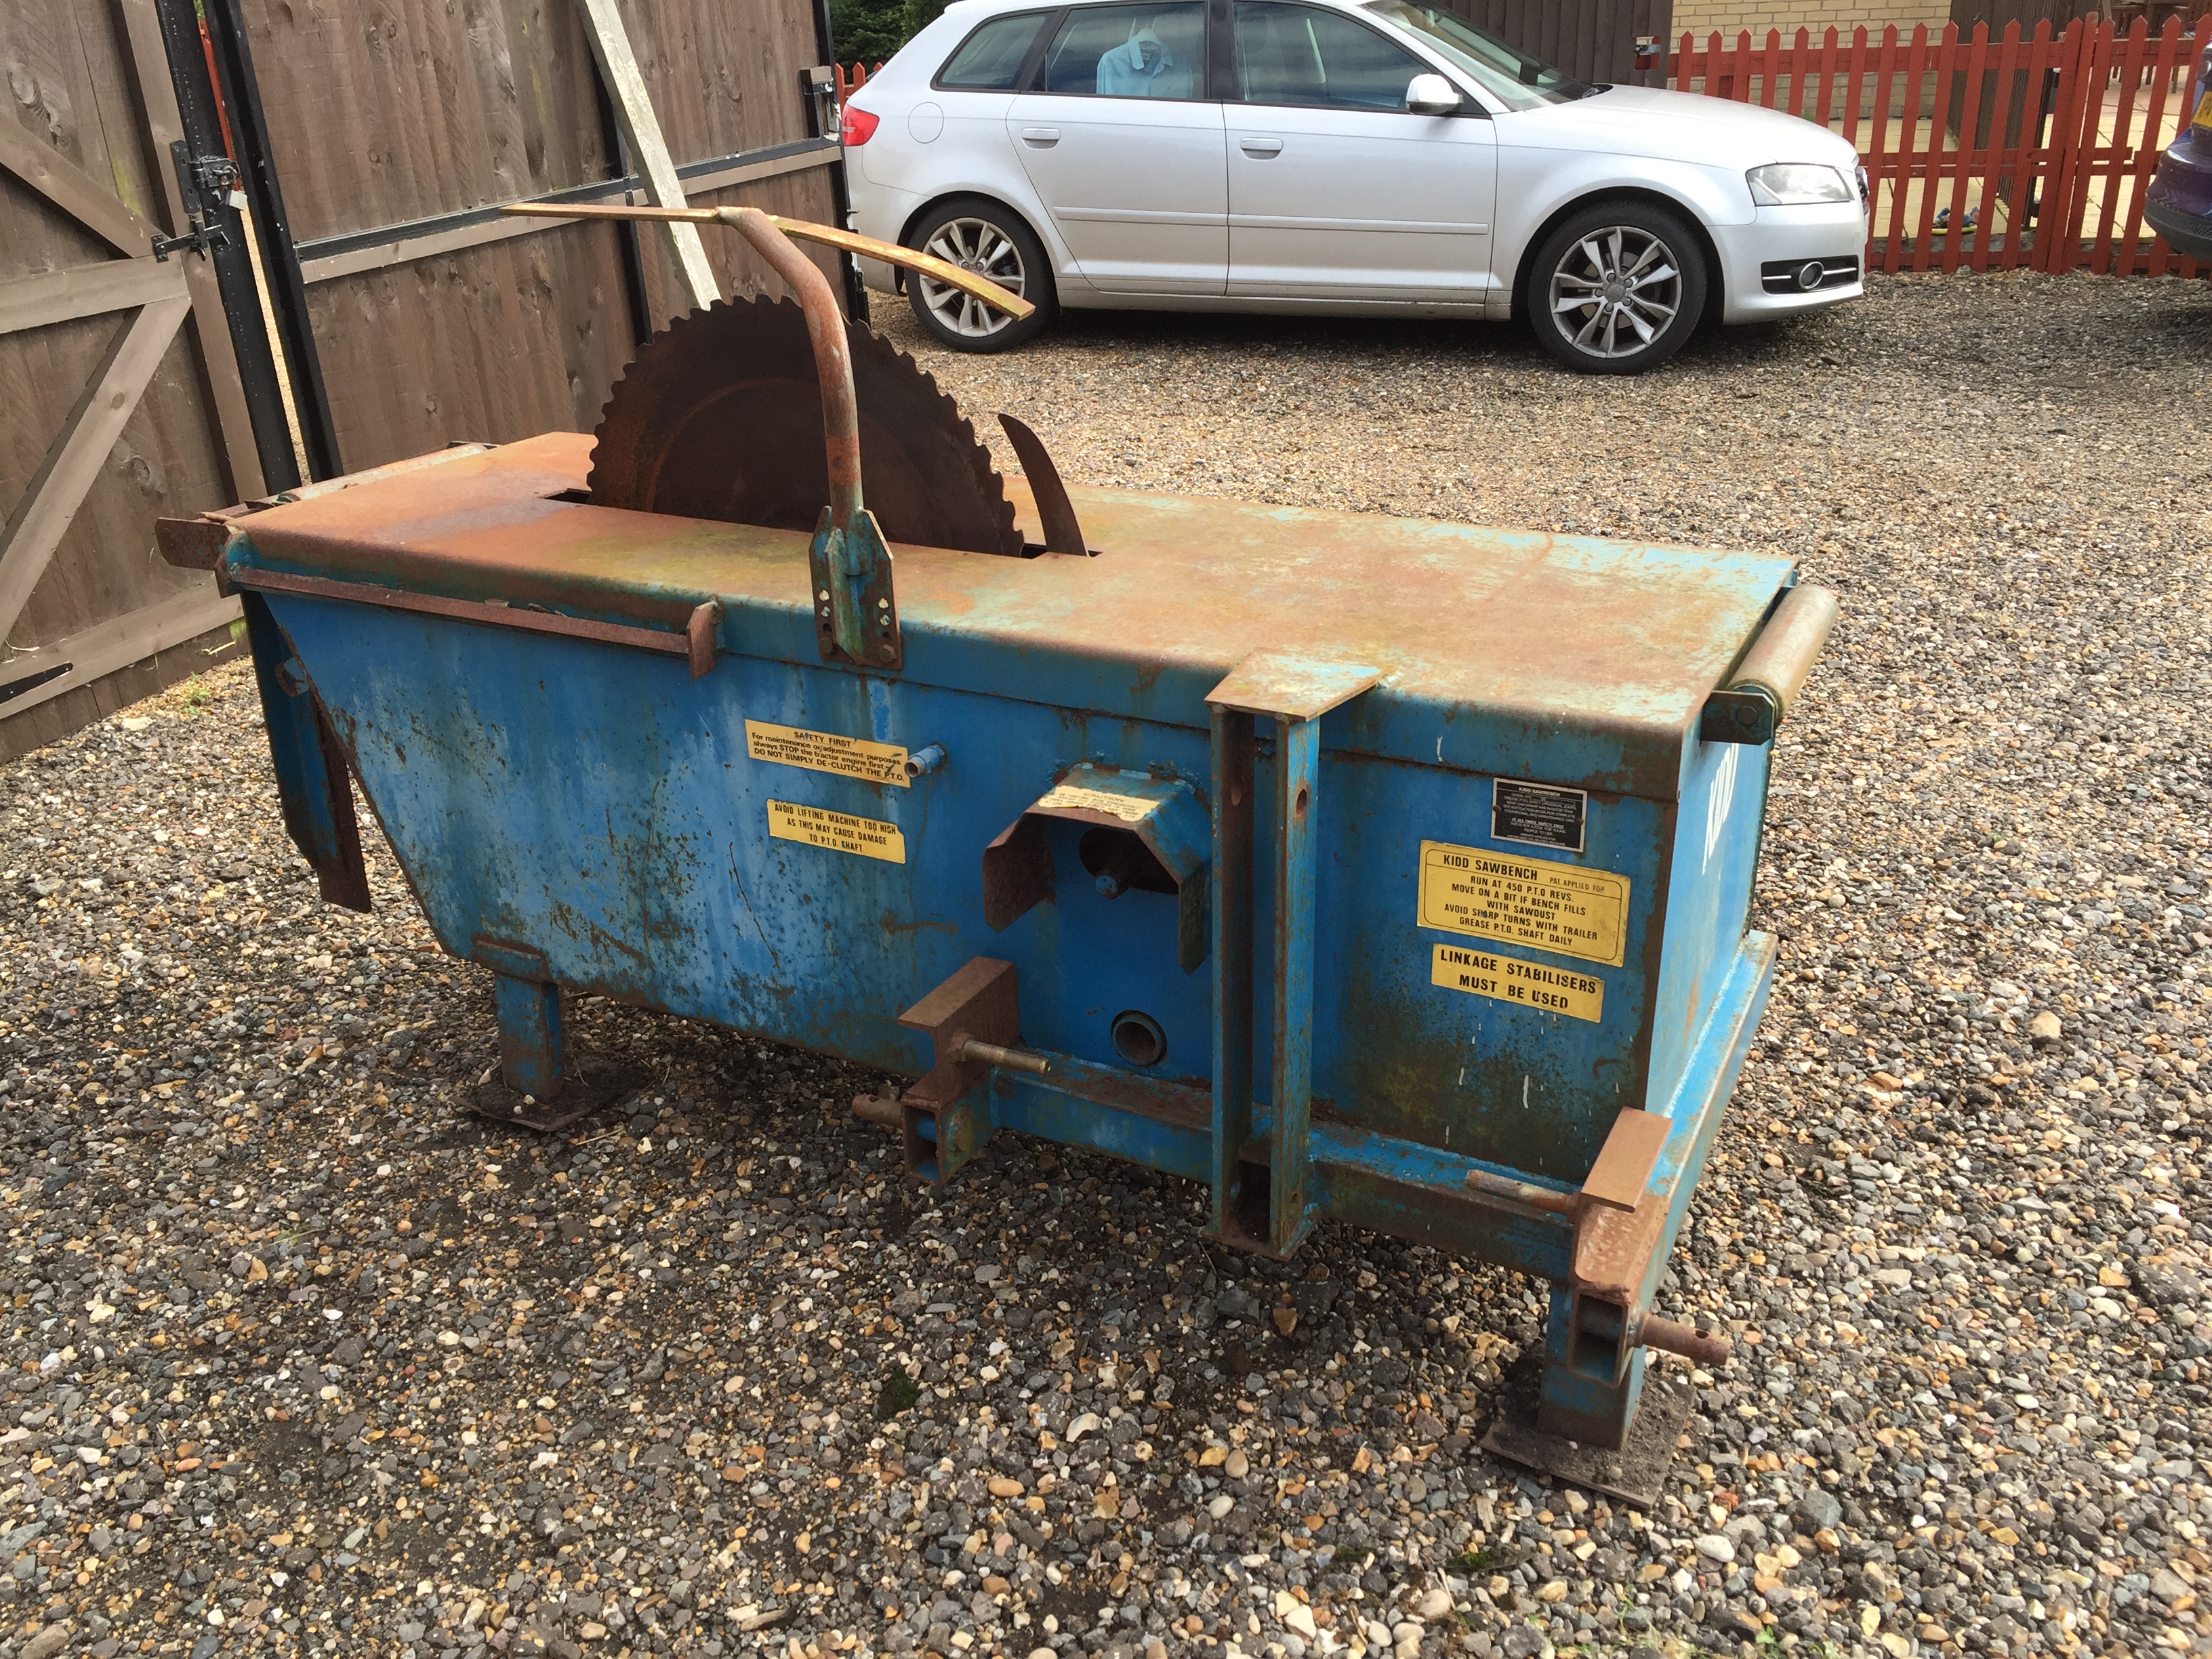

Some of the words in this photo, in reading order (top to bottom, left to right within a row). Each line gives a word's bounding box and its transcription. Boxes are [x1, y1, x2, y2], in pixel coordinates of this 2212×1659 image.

[754, 741, 778, 750] always
[779, 745, 799, 753] STOP
[815, 751, 838, 760] tractor
[842, 756, 867, 766] engine
[869, 760, 884, 769] first
[765, 736, 811, 748] maintenance
[823, 745, 864, 758] adjustment
[867, 754, 901, 765] purposes
[829, 738, 851, 747] FIRST
[767, 750, 782, 758] NOT
[785, 753, 813, 764] SIMPLY
[817, 759, 862, 773] DE-CLUTCH
[866, 769, 881, 777] THE
[884, 772, 904, 781] P.T.O.
[1084, 793, 1125, 802] CAUTION
[775, 803, 794, 814] AVOID
[798, 808, 824, 820] LIFTING
[828, 814, 860, 827] MACHINE
[864, 821, 877, 832] TOO
[880, 825, 896, 834] HIGH
[787, 818, 796, 827] AS
[800, 820, 813, 830] THIS
[816, 823, 830, 834] MAY
[834, 827, 855, 838] CAUSE
[858, 833, 887, 845] DAMAGE
[809, 834, 818, 842] TO
[1443, 854, 1469, 868] KIDD
[1475, 860, 1538, 881] SAWBENCH
[1563, 878, 1590, 890] APPLIED
[1593, 885, 1605, 893] FOR
[1452, 883, 1475, 895] MOVE
[1478, 888, 1490, 897] ON
[1494, 891, 1500, 899] A
[1504, 892, 1516, 903] BIT
[1520, 895, 1528, 904] IF
[1532, 897, 1559, 911] BENCH
[1564, 904, 1586, 916] FILLS
[1471, 876, 1488, 886] RUN
[1492, 879, 1502, 888] AT
[1507, 882, 1523, 893] 450
[1550, 889, 1574, 902] REVS.
[1444, 903, 1468, 915] AVOID
[1503, 914, 1532, 926] TURNS
[1536, 920, 1558, 933] WITH
[1563, 925, 1597, 941] TRAILER
[1487, 900, 1509, 912] WITH
[1513, 905, 1556, 920] SAWDUST
[1460, 916, 1490, 930] GREASE
[1518, 927, 1544, 941] SHAFT
[1549, 933, 1573, 946] DAILY
[1441, 949, 1498, 972] LINKAGE
[1507, 963, 1597, 994] STABILISERS
[1459, 975, 1498, 992] MUST
[1508, 985, 1525, 999] BE
[1532, 991, 1568, 1008] USED
